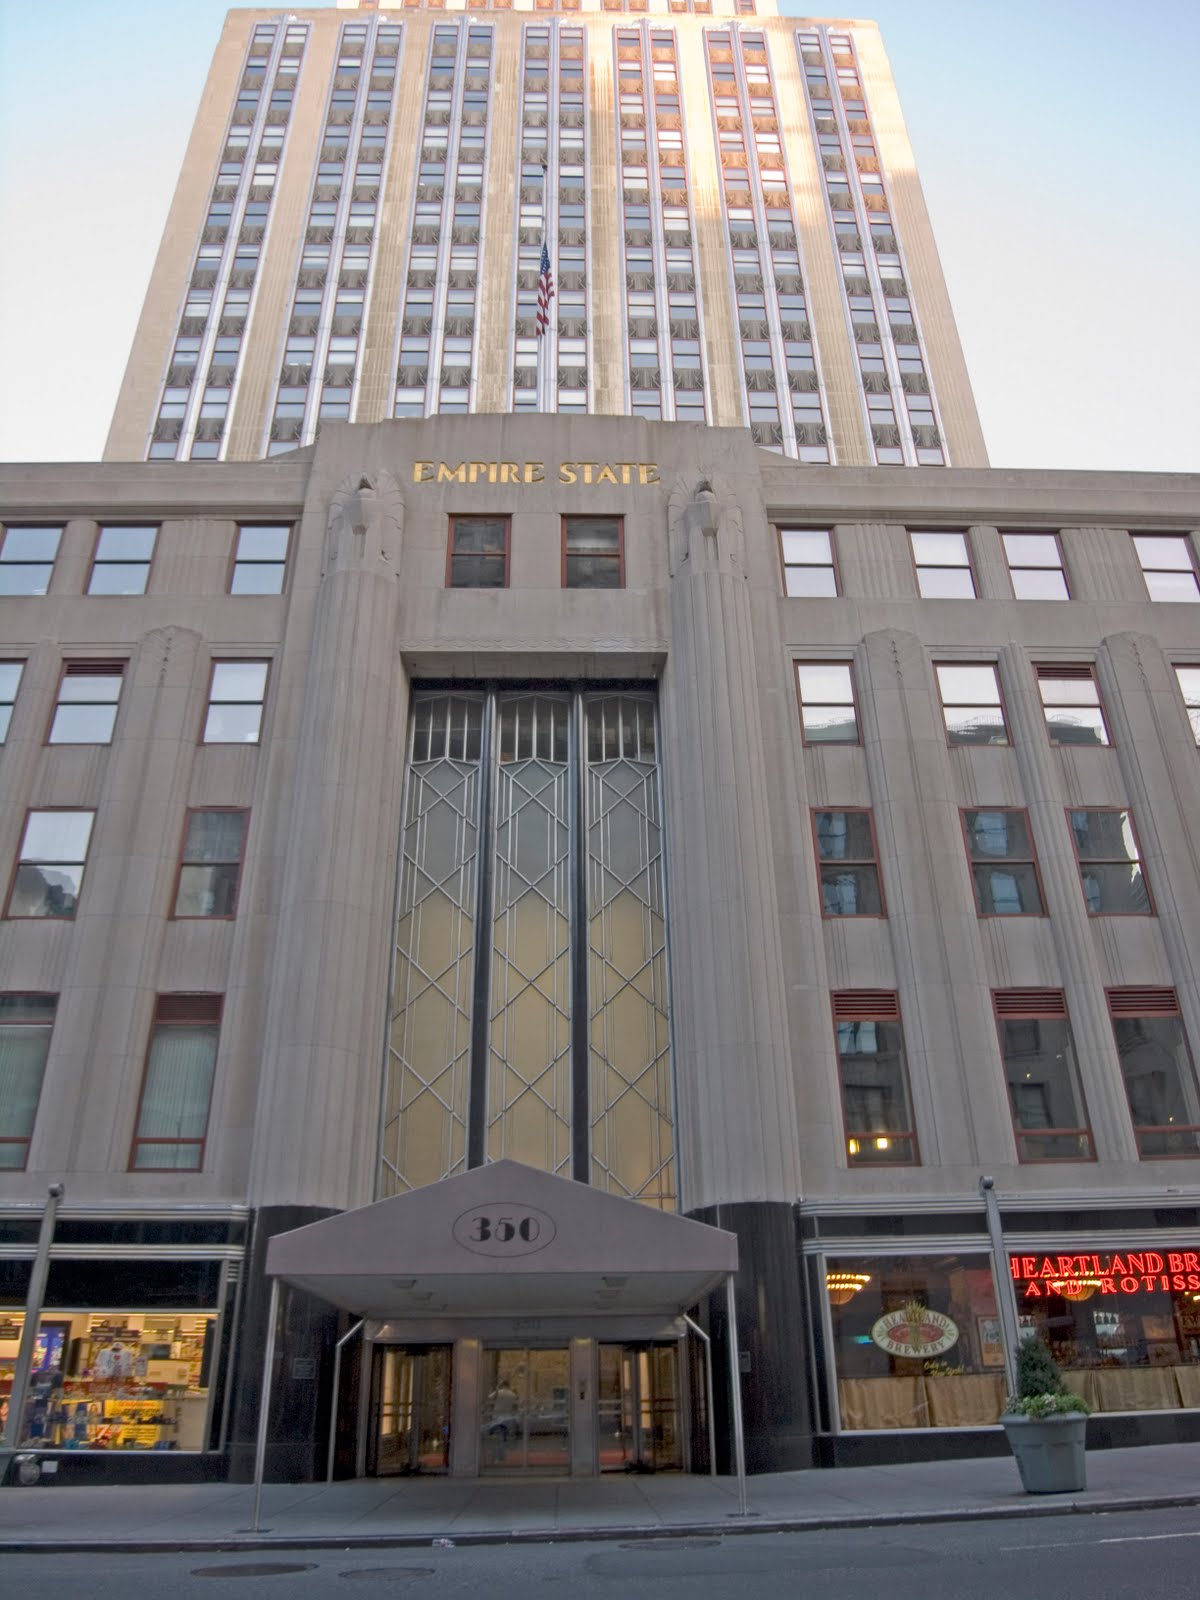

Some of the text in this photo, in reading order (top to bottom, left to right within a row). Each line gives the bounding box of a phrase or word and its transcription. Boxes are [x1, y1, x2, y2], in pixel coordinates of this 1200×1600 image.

[413, 461, 661, 485] EMPIRE STATE
[469, 1216, 540, 1242] 350
[1025, 1279, 1083, 1297] AND
